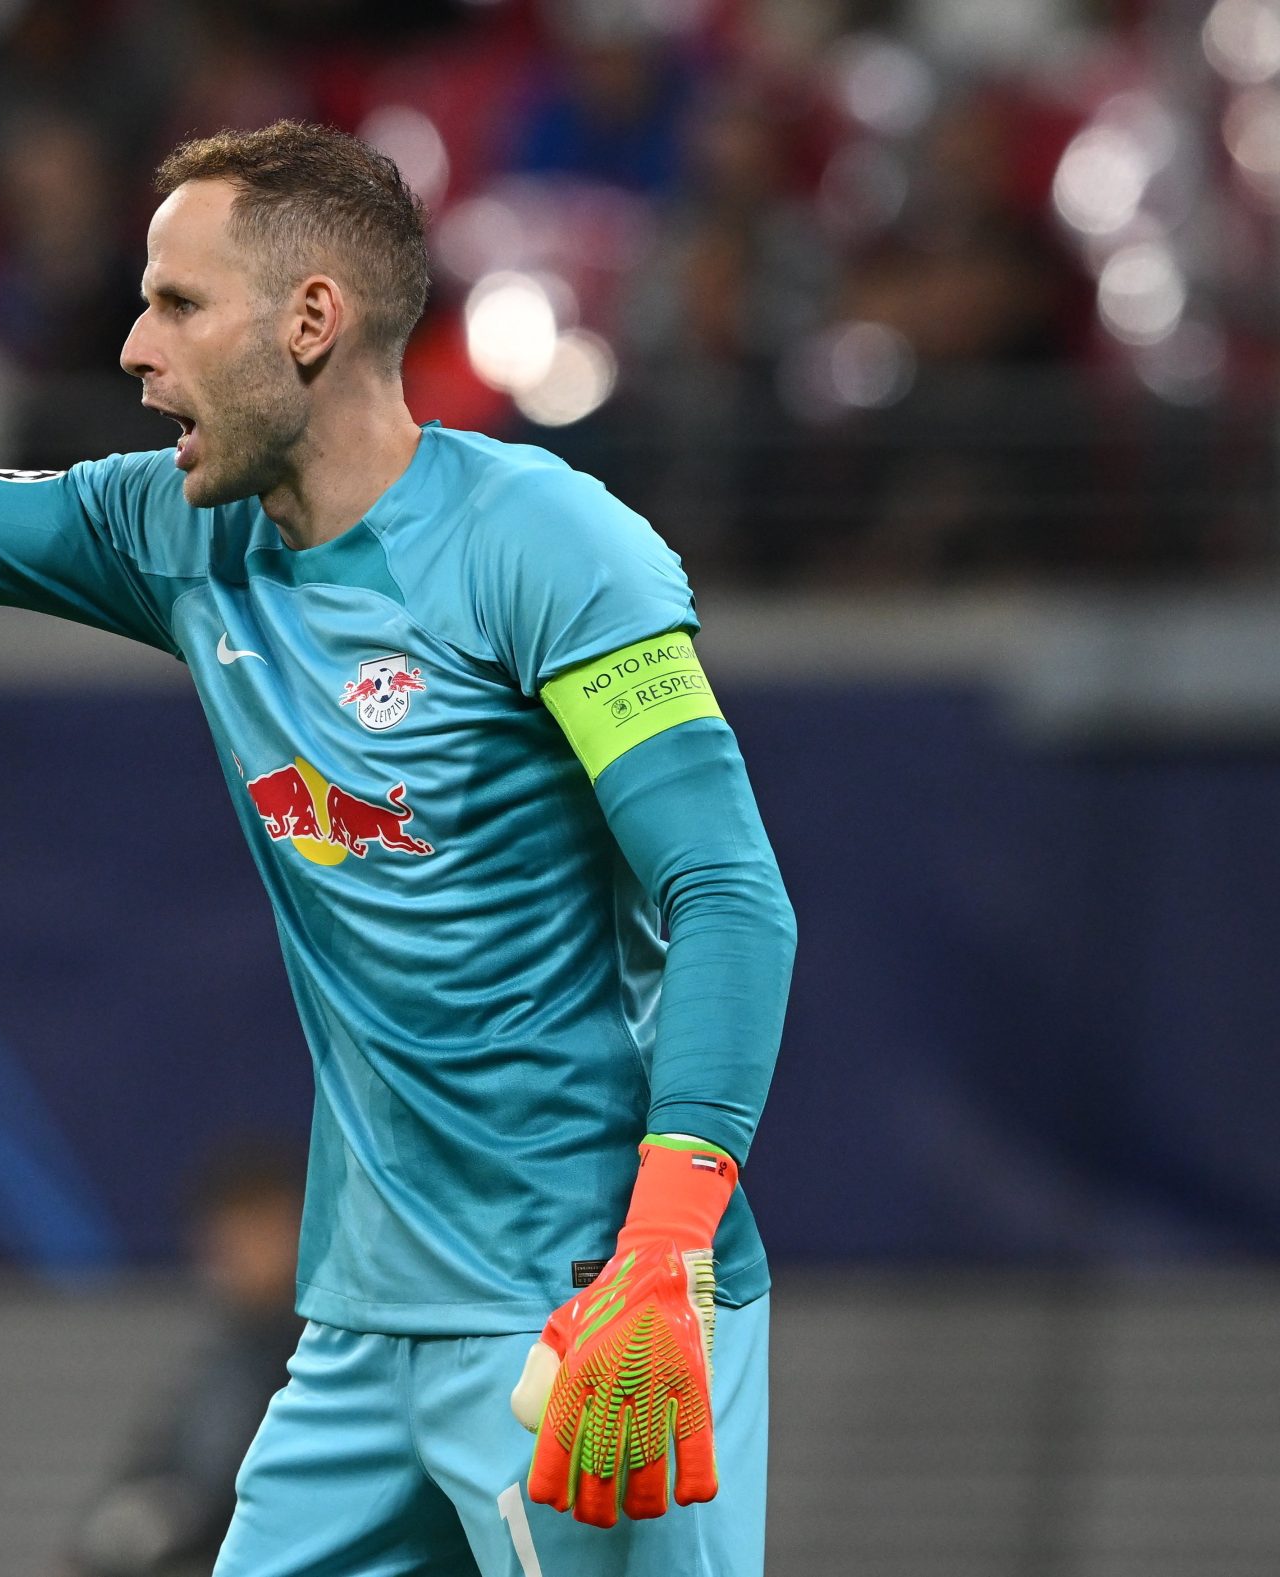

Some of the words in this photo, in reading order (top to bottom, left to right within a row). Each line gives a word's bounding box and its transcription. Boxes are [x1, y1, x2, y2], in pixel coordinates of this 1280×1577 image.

[582, 673, 612, 699] NO
[612, 658, 640, 678] TO
[635, 675, 707, 706] RESPECT
[363, 703, 376, 719] RB
[374, 697, 405, 723] LEIPZIG
[496, 1481, 543, 1577] 1
